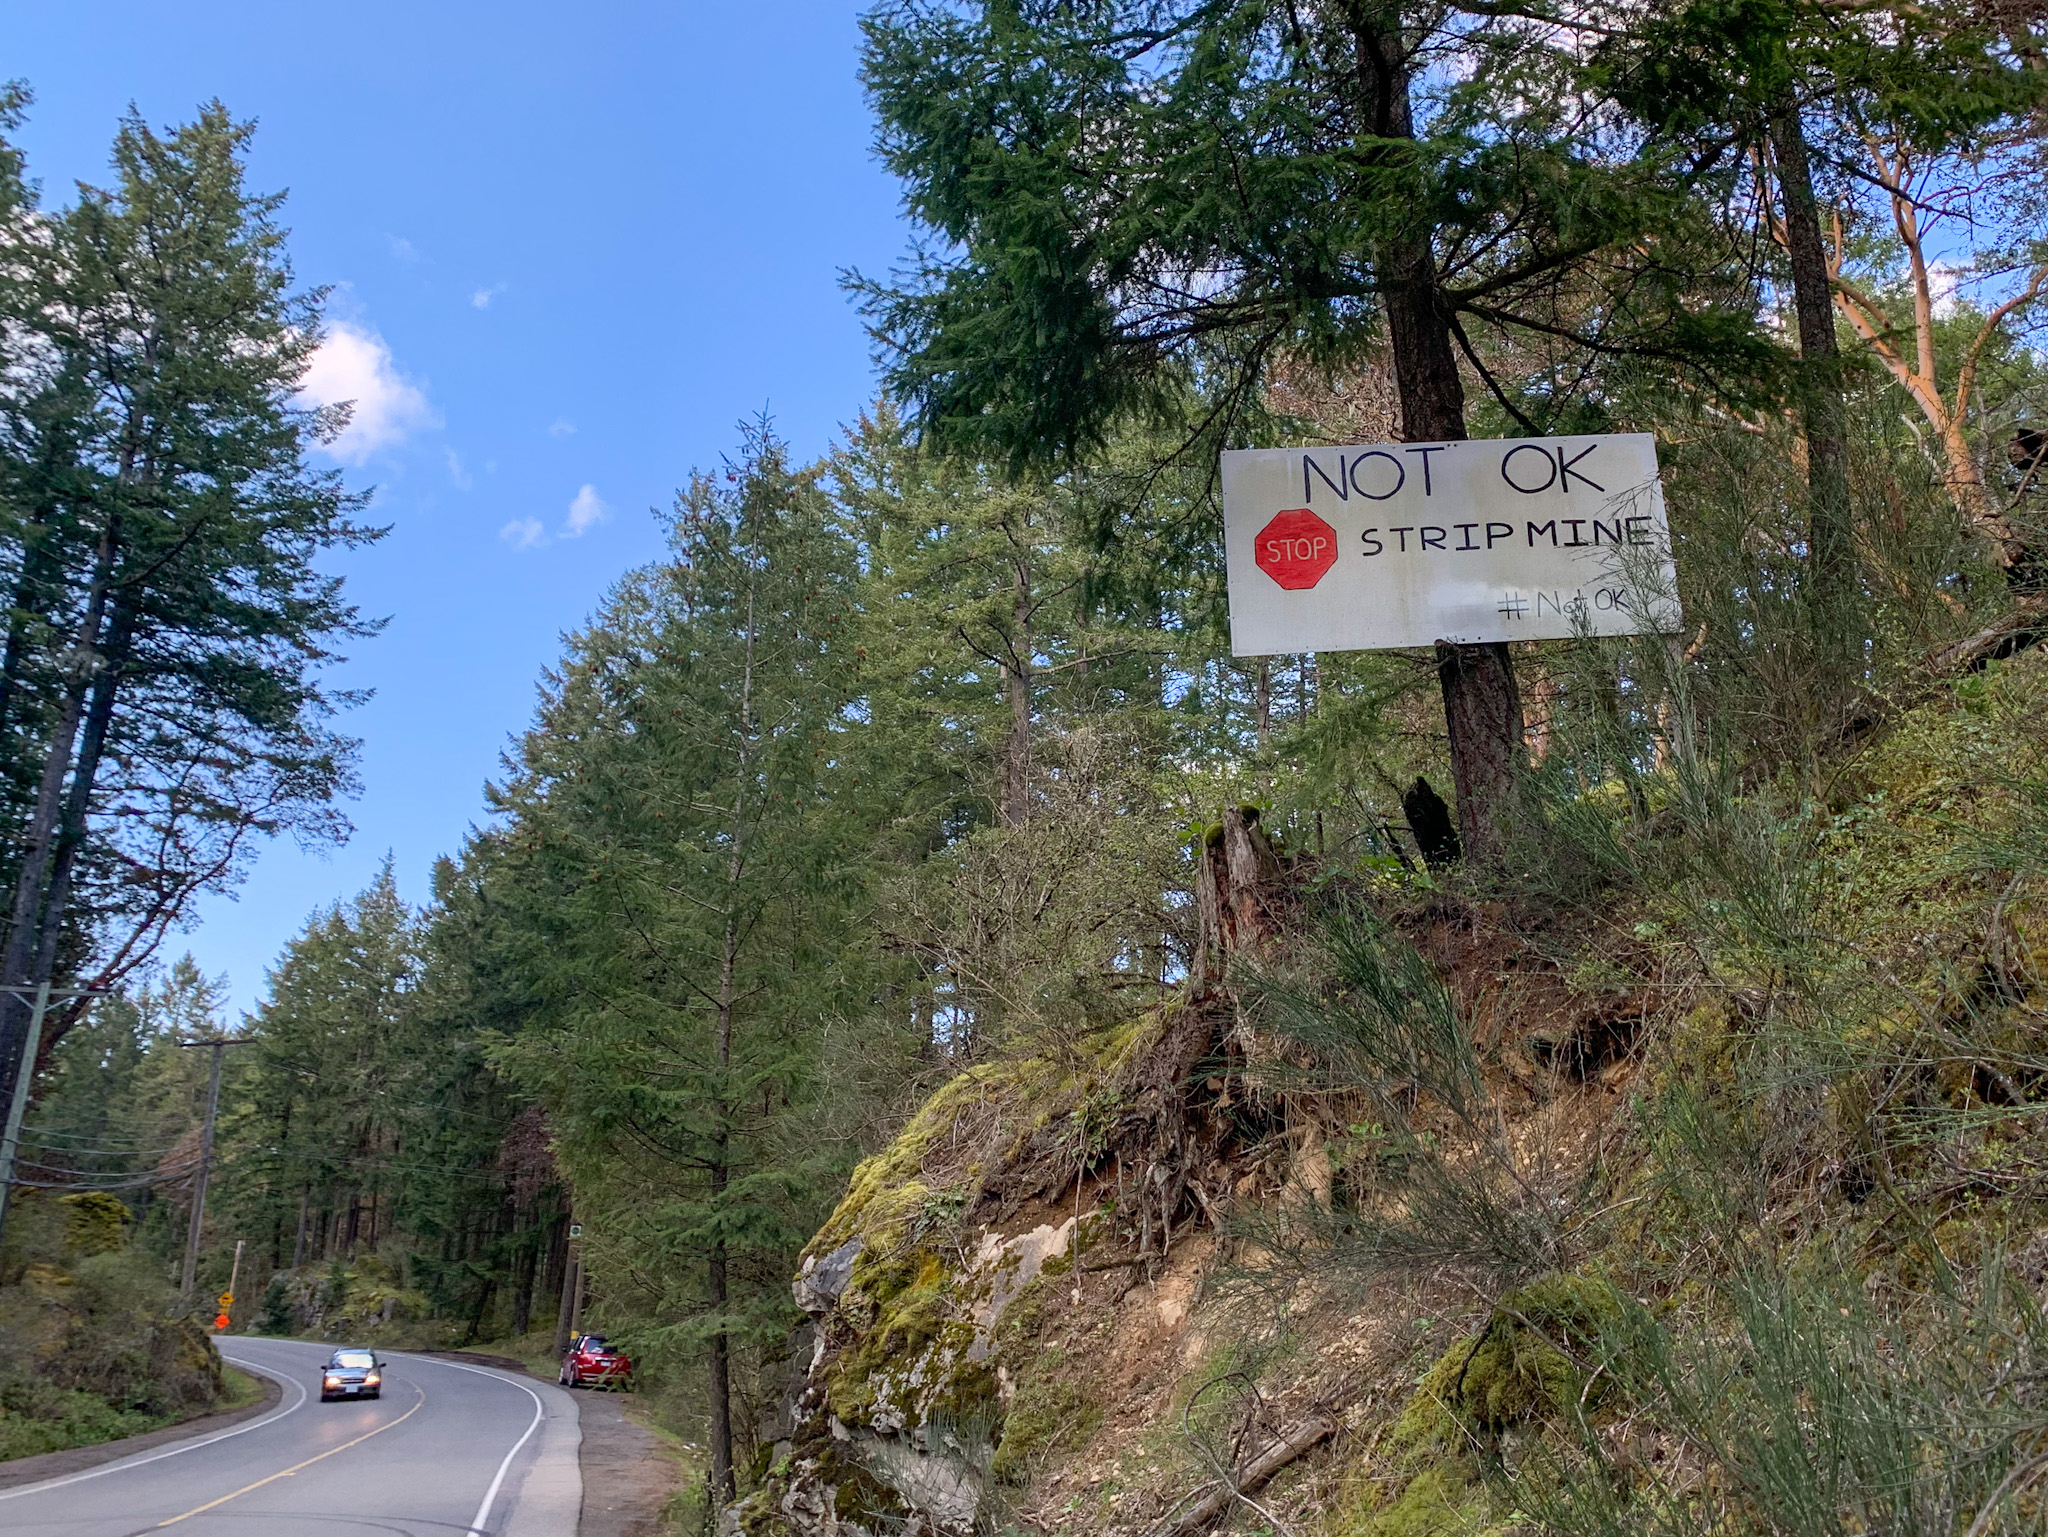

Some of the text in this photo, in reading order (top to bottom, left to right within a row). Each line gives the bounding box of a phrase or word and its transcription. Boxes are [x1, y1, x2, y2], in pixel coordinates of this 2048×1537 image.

[1303, 444, 1605, 503] NOT OK
[1266, 536, 1327, 563] STOP
